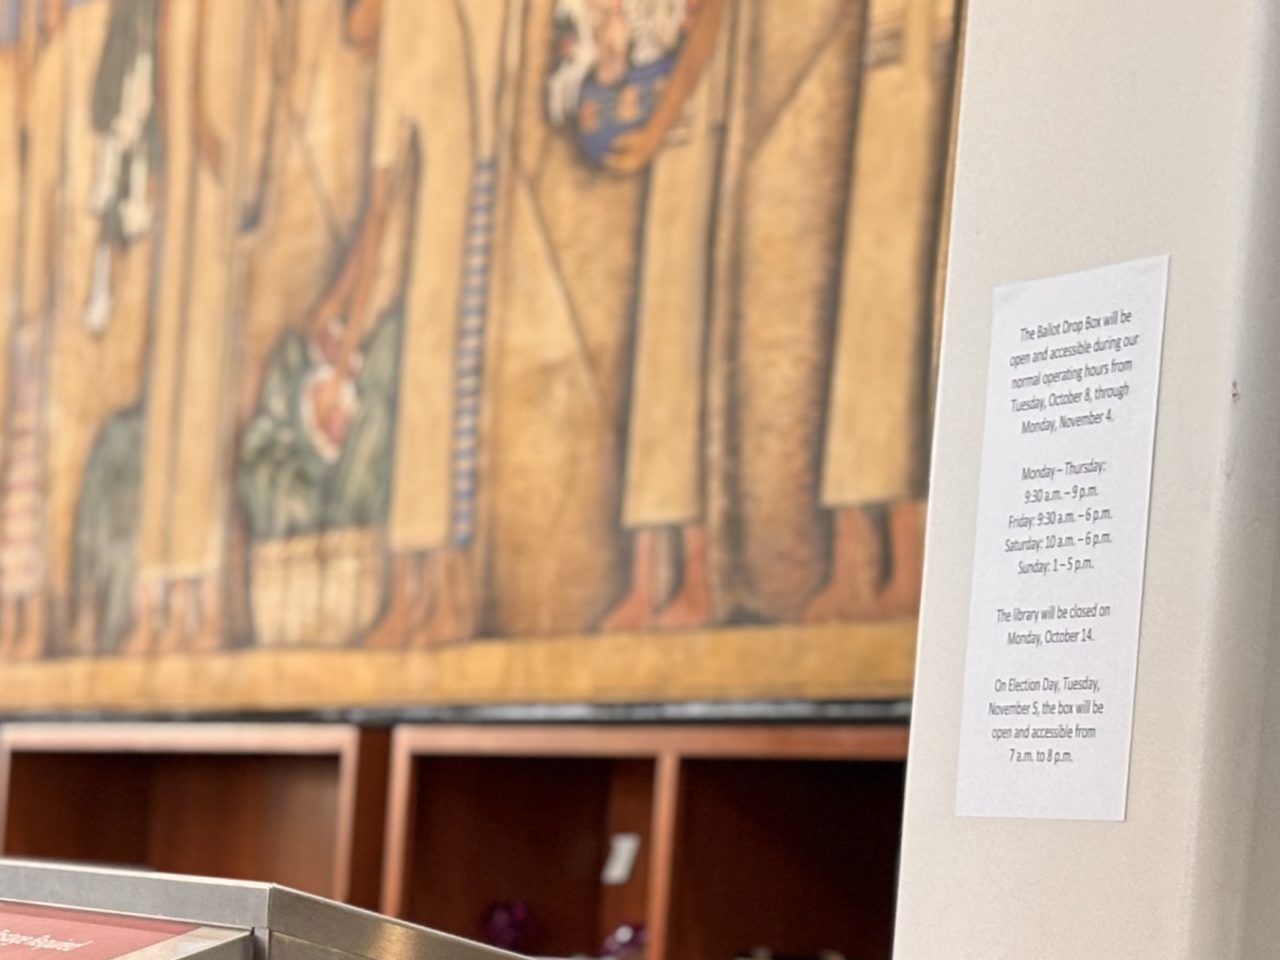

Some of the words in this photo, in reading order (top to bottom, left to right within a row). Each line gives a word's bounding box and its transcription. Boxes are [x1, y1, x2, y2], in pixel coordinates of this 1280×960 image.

[1020, 328, 1035, 341] The
[1037, 323, 1060, 339] Ballot
[1062, 319, 1083, 335] Drop
[1085, 315, 1102, 330] Box
[1103, 309, 1118, 327] will
[1120, 309, 1132, 325] be
[1009, 352, 1031, 368] open
[1032, 347, 1049, 363] and
[1049, 340, 1091, 359] accessible
[1093, 337, 1122, 353] during
[1123, 334, 1139, 347] our
[1011, 372, 1041, 389] normal
[1042, 366, 1083, 385] operating
[1084, 361, 1109, 377] hours
[1111, 359, 1133, 373] from
[1011, 396, 1047, 412] Tuesday,
[1048, 391, 1083, 407] October
[1084, 388, 1092, 401] 8,
[1094, 382, 1130, 401] through
[1021, 418, 1057, 435] Monday,
[1059, 412, 1104, 429] November
[1022, 464, 1055, 481] Monday
[1064, 458, 1106, 476] Thursday:
[1024, 488, 1043, 504] 9:30
[1044, 489, 1063, 502] a.m.
[1072, 485, 1078, 499] 9
[1079, 484, 1099, 500] p.m.
[1008, 514, 1036, 530] Friday:
[1037, 511, 1056, 526] 9:30
[1057, 511, 1076, 524] a.m.
[1085, 508, 1092, 521] 6
[1092, 507, 1113, 524] p.m.
[1004, 537, 1044, 553] Saturday:
[1045, 535, 1055, 549] 10
[1057, 535, 1076, 547] a.m.
[1085, 531, 1092, 545] 6
[1092, 532, 1113, 548] p.m.
[1018, 560, 1051, 576] Sunday:
[1053, 558, 1058, 572] 1
[1067, 557, 1073, 571] 5
[1074, 557, 1094, 573] p.m.
[997, 608, 1011, 623] The
[1013, 607, 1039, 623] library
[1041, 606, 1055, 620] will
[1057, 605, 1068, 619] be
[1069, 603, 1097, 619] closed
[1099, 605, 1111, 617] on
[1007, 630, 1043, 647] Monday,
[1045, 628, 1080, 644] October
[1081, 627, 1095, 642] 14.
[994, 678, 1007, 693] On
[1008, 678, 1041, 693] Election
[1042, 677, 1060, 694] Day,
[1063, 676, 1101, 693] Tuesday,
[988, 701, 1031, 716] November
[1032, 702, 1040, 717] 5,
[1042, 702, 1055, 715] the
[1057, 701, 1074, 715] box
[1075, 700, 1091, 714] will
[1092, 700, 1104, 714] be
[991, 727, 1012, 741] open
[1014, 725, 1029, 739] and
[1031, 724, 1073, 739] accessible
[1075, 724, 1096, 738] from
[1009, 749, 1015, 762] 7
[1016, 750, 1034, 762] a.m.
[1036, 749, 1046, 762] to
[1047, 748, 1053, 762] 8
[1054, 749, 1074, 765] p.m.
